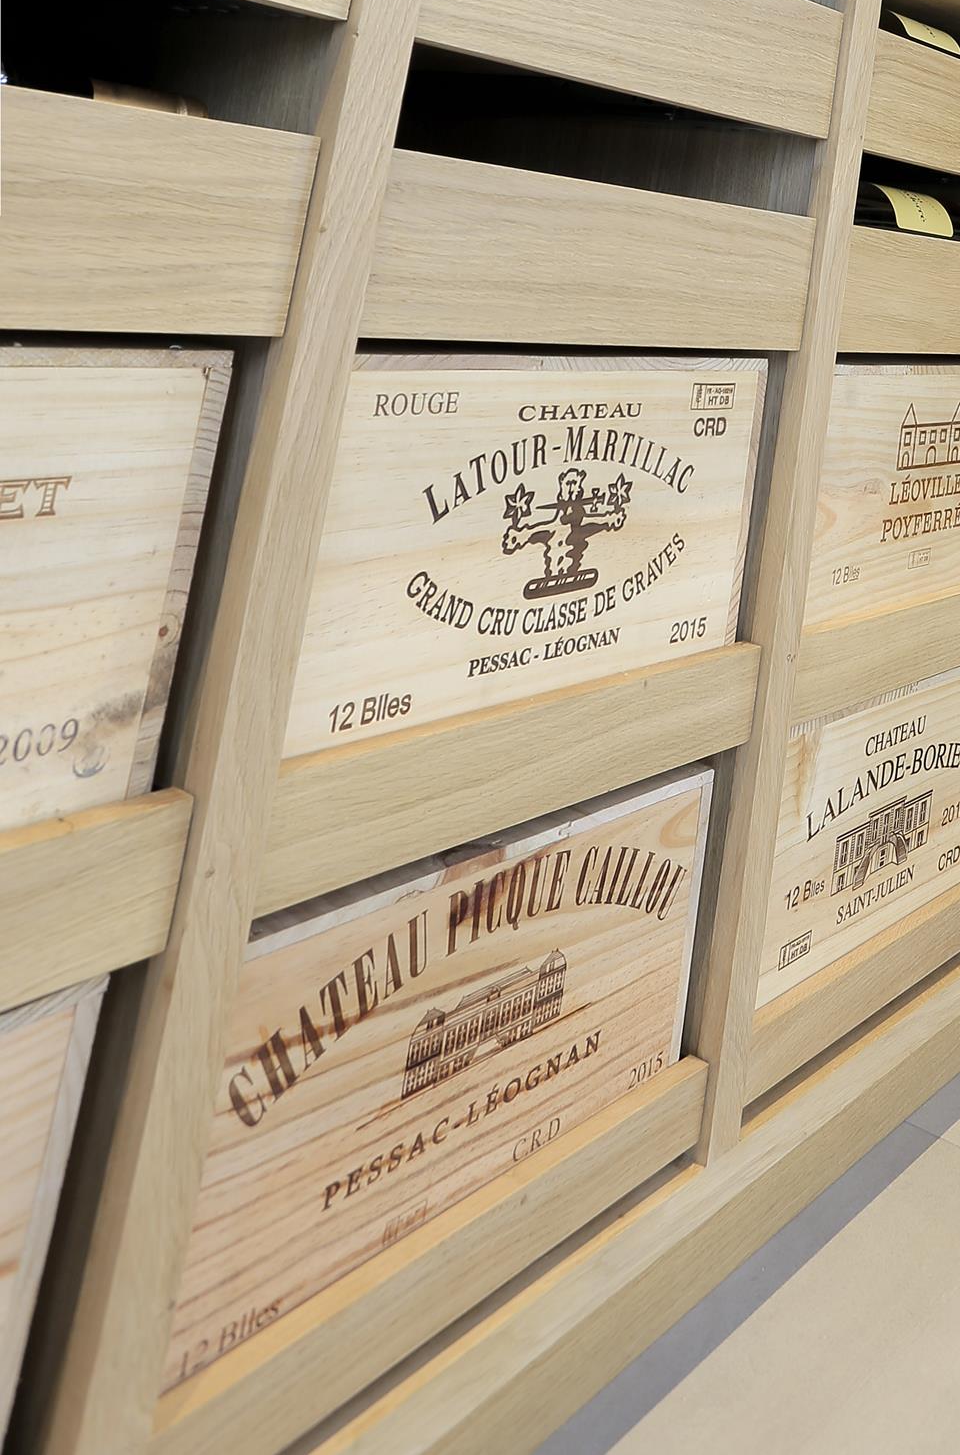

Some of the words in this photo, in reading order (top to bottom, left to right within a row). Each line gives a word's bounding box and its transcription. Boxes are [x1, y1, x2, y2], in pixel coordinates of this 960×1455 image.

[373, 392, 460, 417] ROUGE
[518, 403, 642, 422] CHATEAU
[694, 417, 727, 437] CRD
[422, 425, 696, 524] LATOUR-MARTILLAC
[406, 570, 473, 630] GRAND
[477, 605, 517, 637] CRU
[522, 597, 588, 635] CLASSE
[593, 585, 617, 618] DE
[622, 532, 687, 603] GRAVES
[832, 568, 842, 585] 12
[669, 616, 707, 645] 2015
[328, 702, 356, 733] 12
[360, 691, 412, 726] Blles
[864, 715, 927, 757] CHATEAU
[937, 845, 960, 873] CRD
[785, 887, 800, 910] 12
[836, 865, 915, 925] SAINT-JULIEN
[227, 911, 430, 1129] CHATEAU
[446, 849, 571, 957] PICQUE
[575, 845, 689, 922] CAILLOU
[627, 1050, 664, 1091] 2015
[321, 1030, 603, 1210] PESSAC-LÉOGNAN
[512, 1117, 563, 1163] C.R.D
